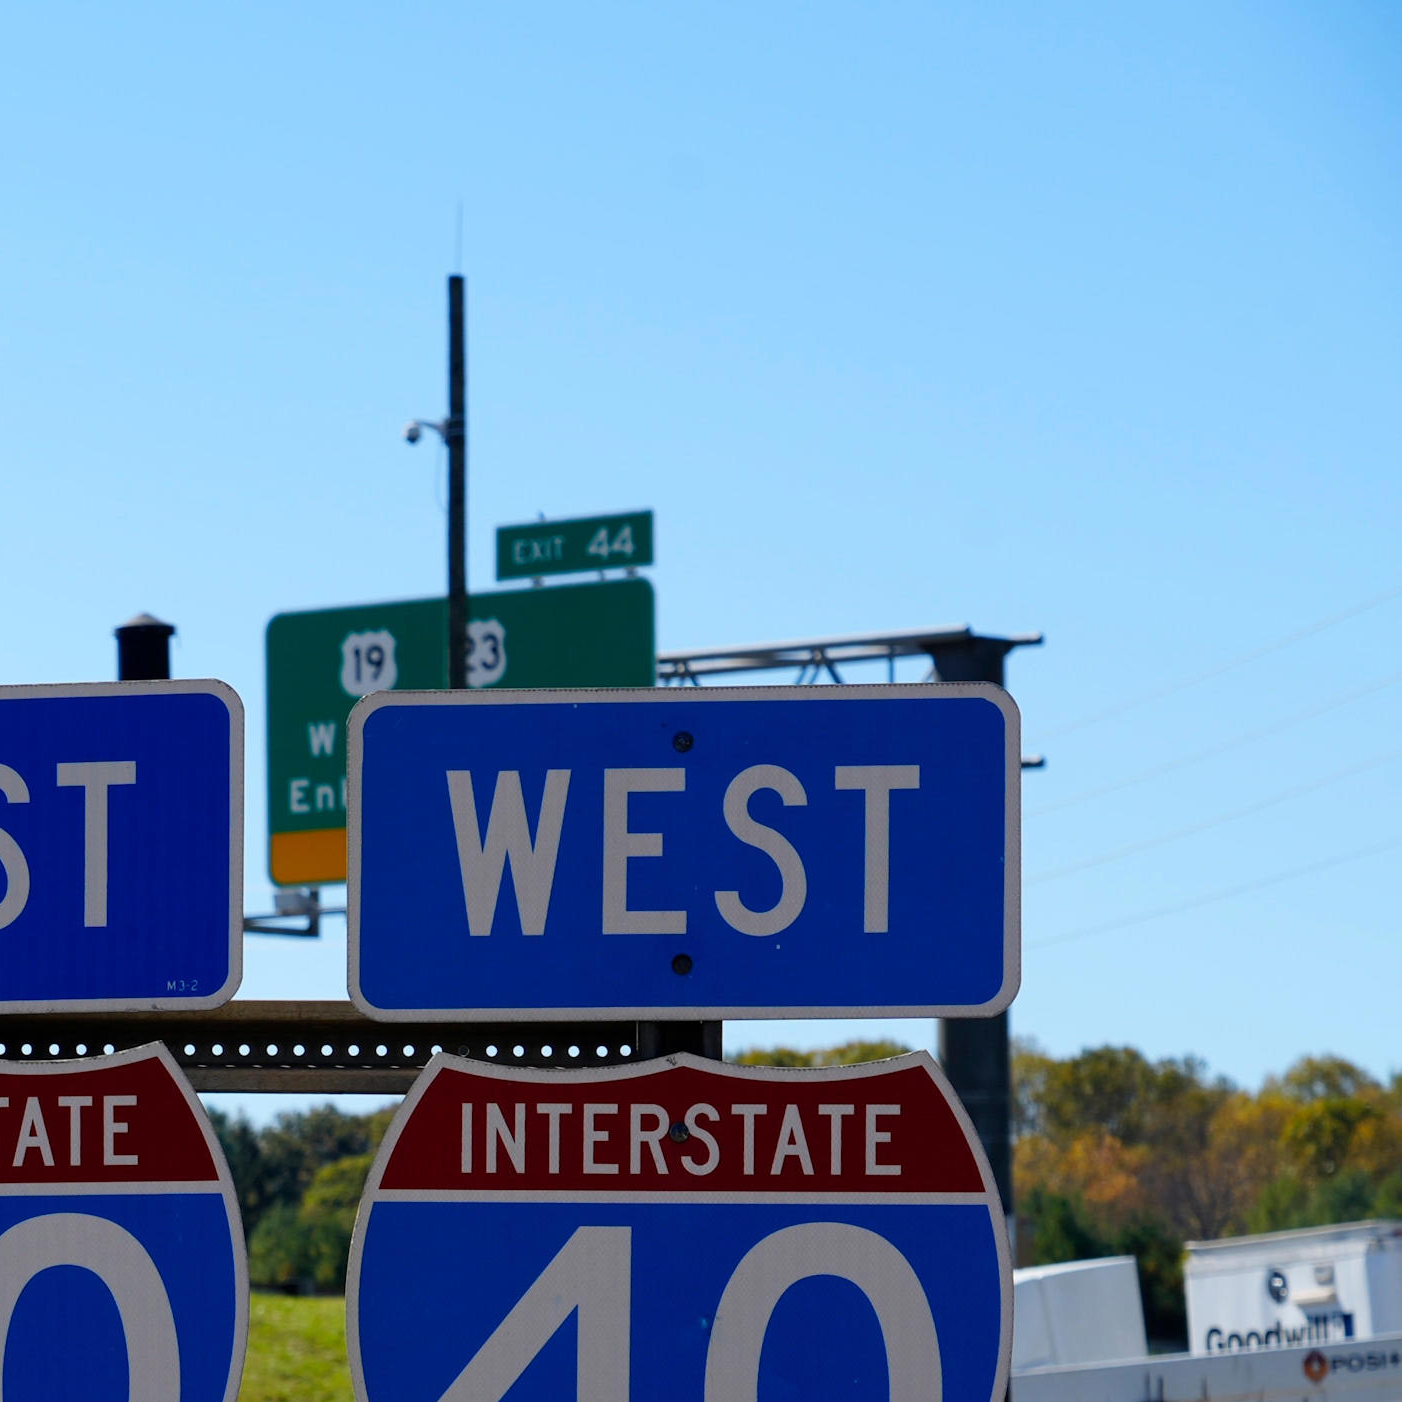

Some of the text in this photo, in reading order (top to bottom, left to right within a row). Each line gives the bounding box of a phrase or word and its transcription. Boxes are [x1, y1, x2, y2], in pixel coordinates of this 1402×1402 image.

[512, 523, 634, 565] EXIT 44
[354, 644, 385, 682] 19
[445, 763, 921, 937] WEST
[166, 979, 198, 992] M3-2
[460, 1102, 903, 1176] INTERSTATE
[1206, 1313, 1329, 1355] Goodwill
